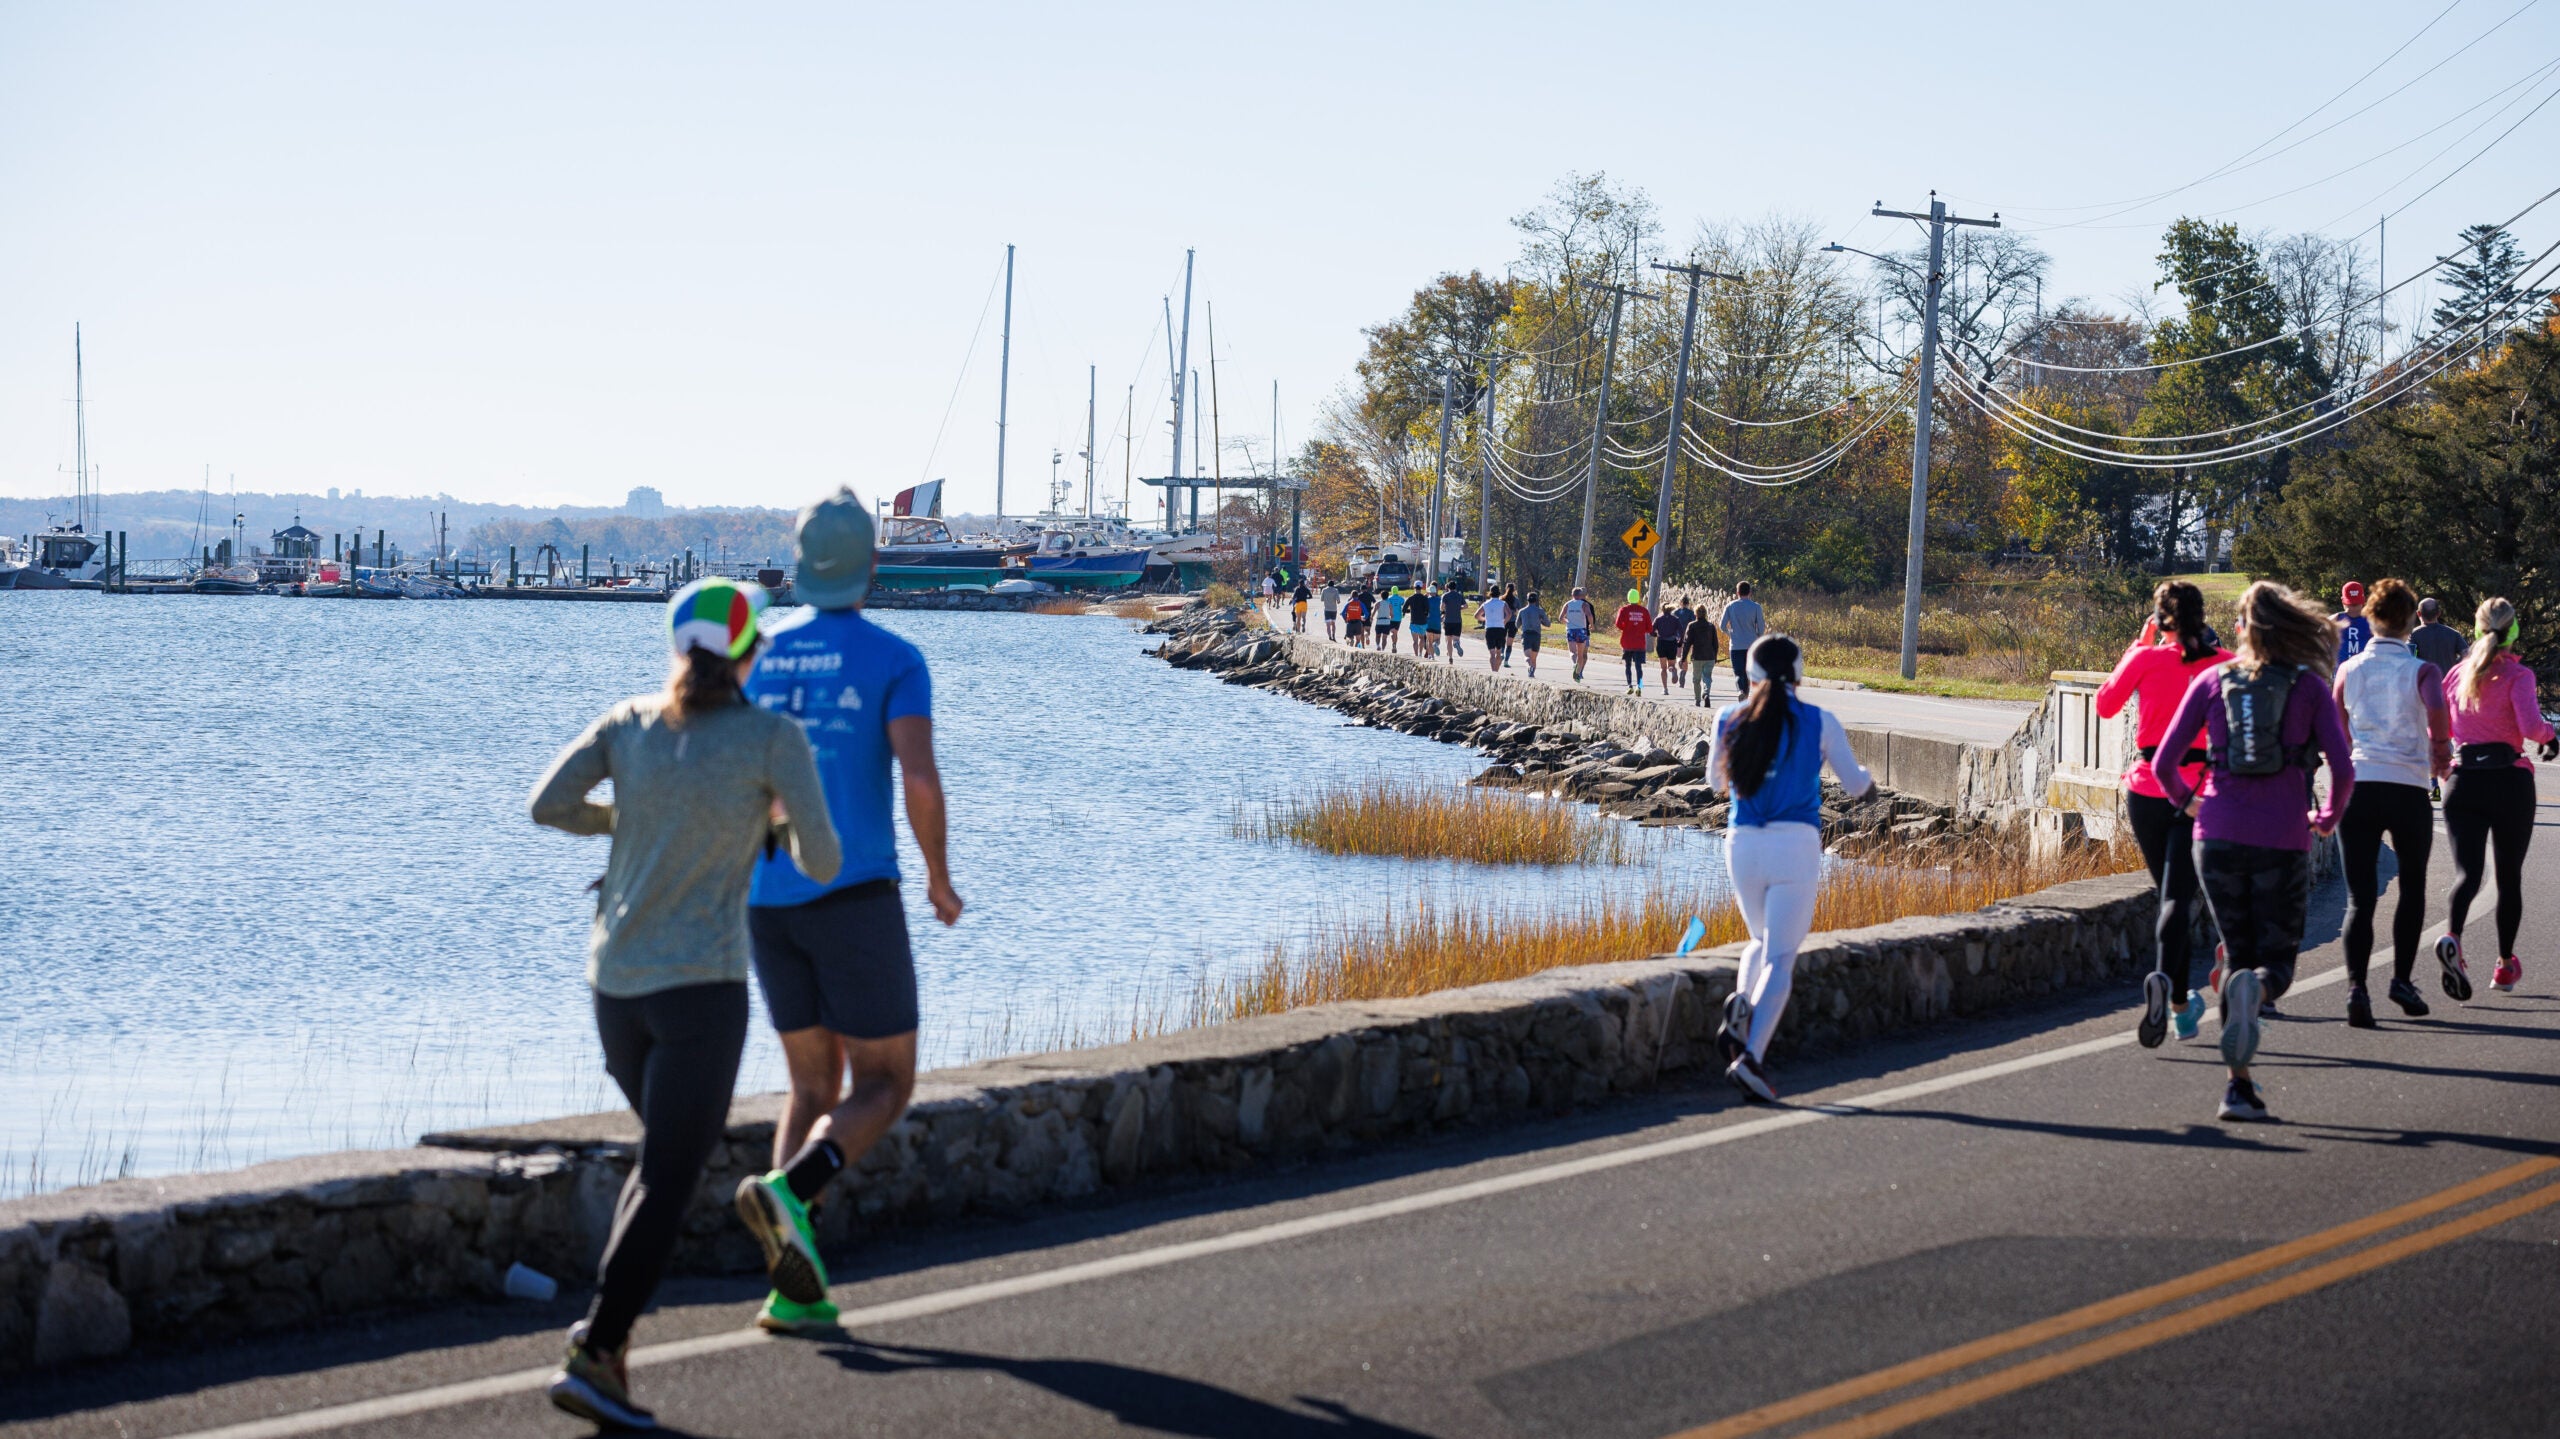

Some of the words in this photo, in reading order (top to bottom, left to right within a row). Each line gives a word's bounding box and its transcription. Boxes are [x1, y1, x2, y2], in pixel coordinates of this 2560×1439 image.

[1632, 560, 1648, 570] 20
[2348, 627, 2360, 658] RM
[2241, 694, 2256, 762] NATHAN
